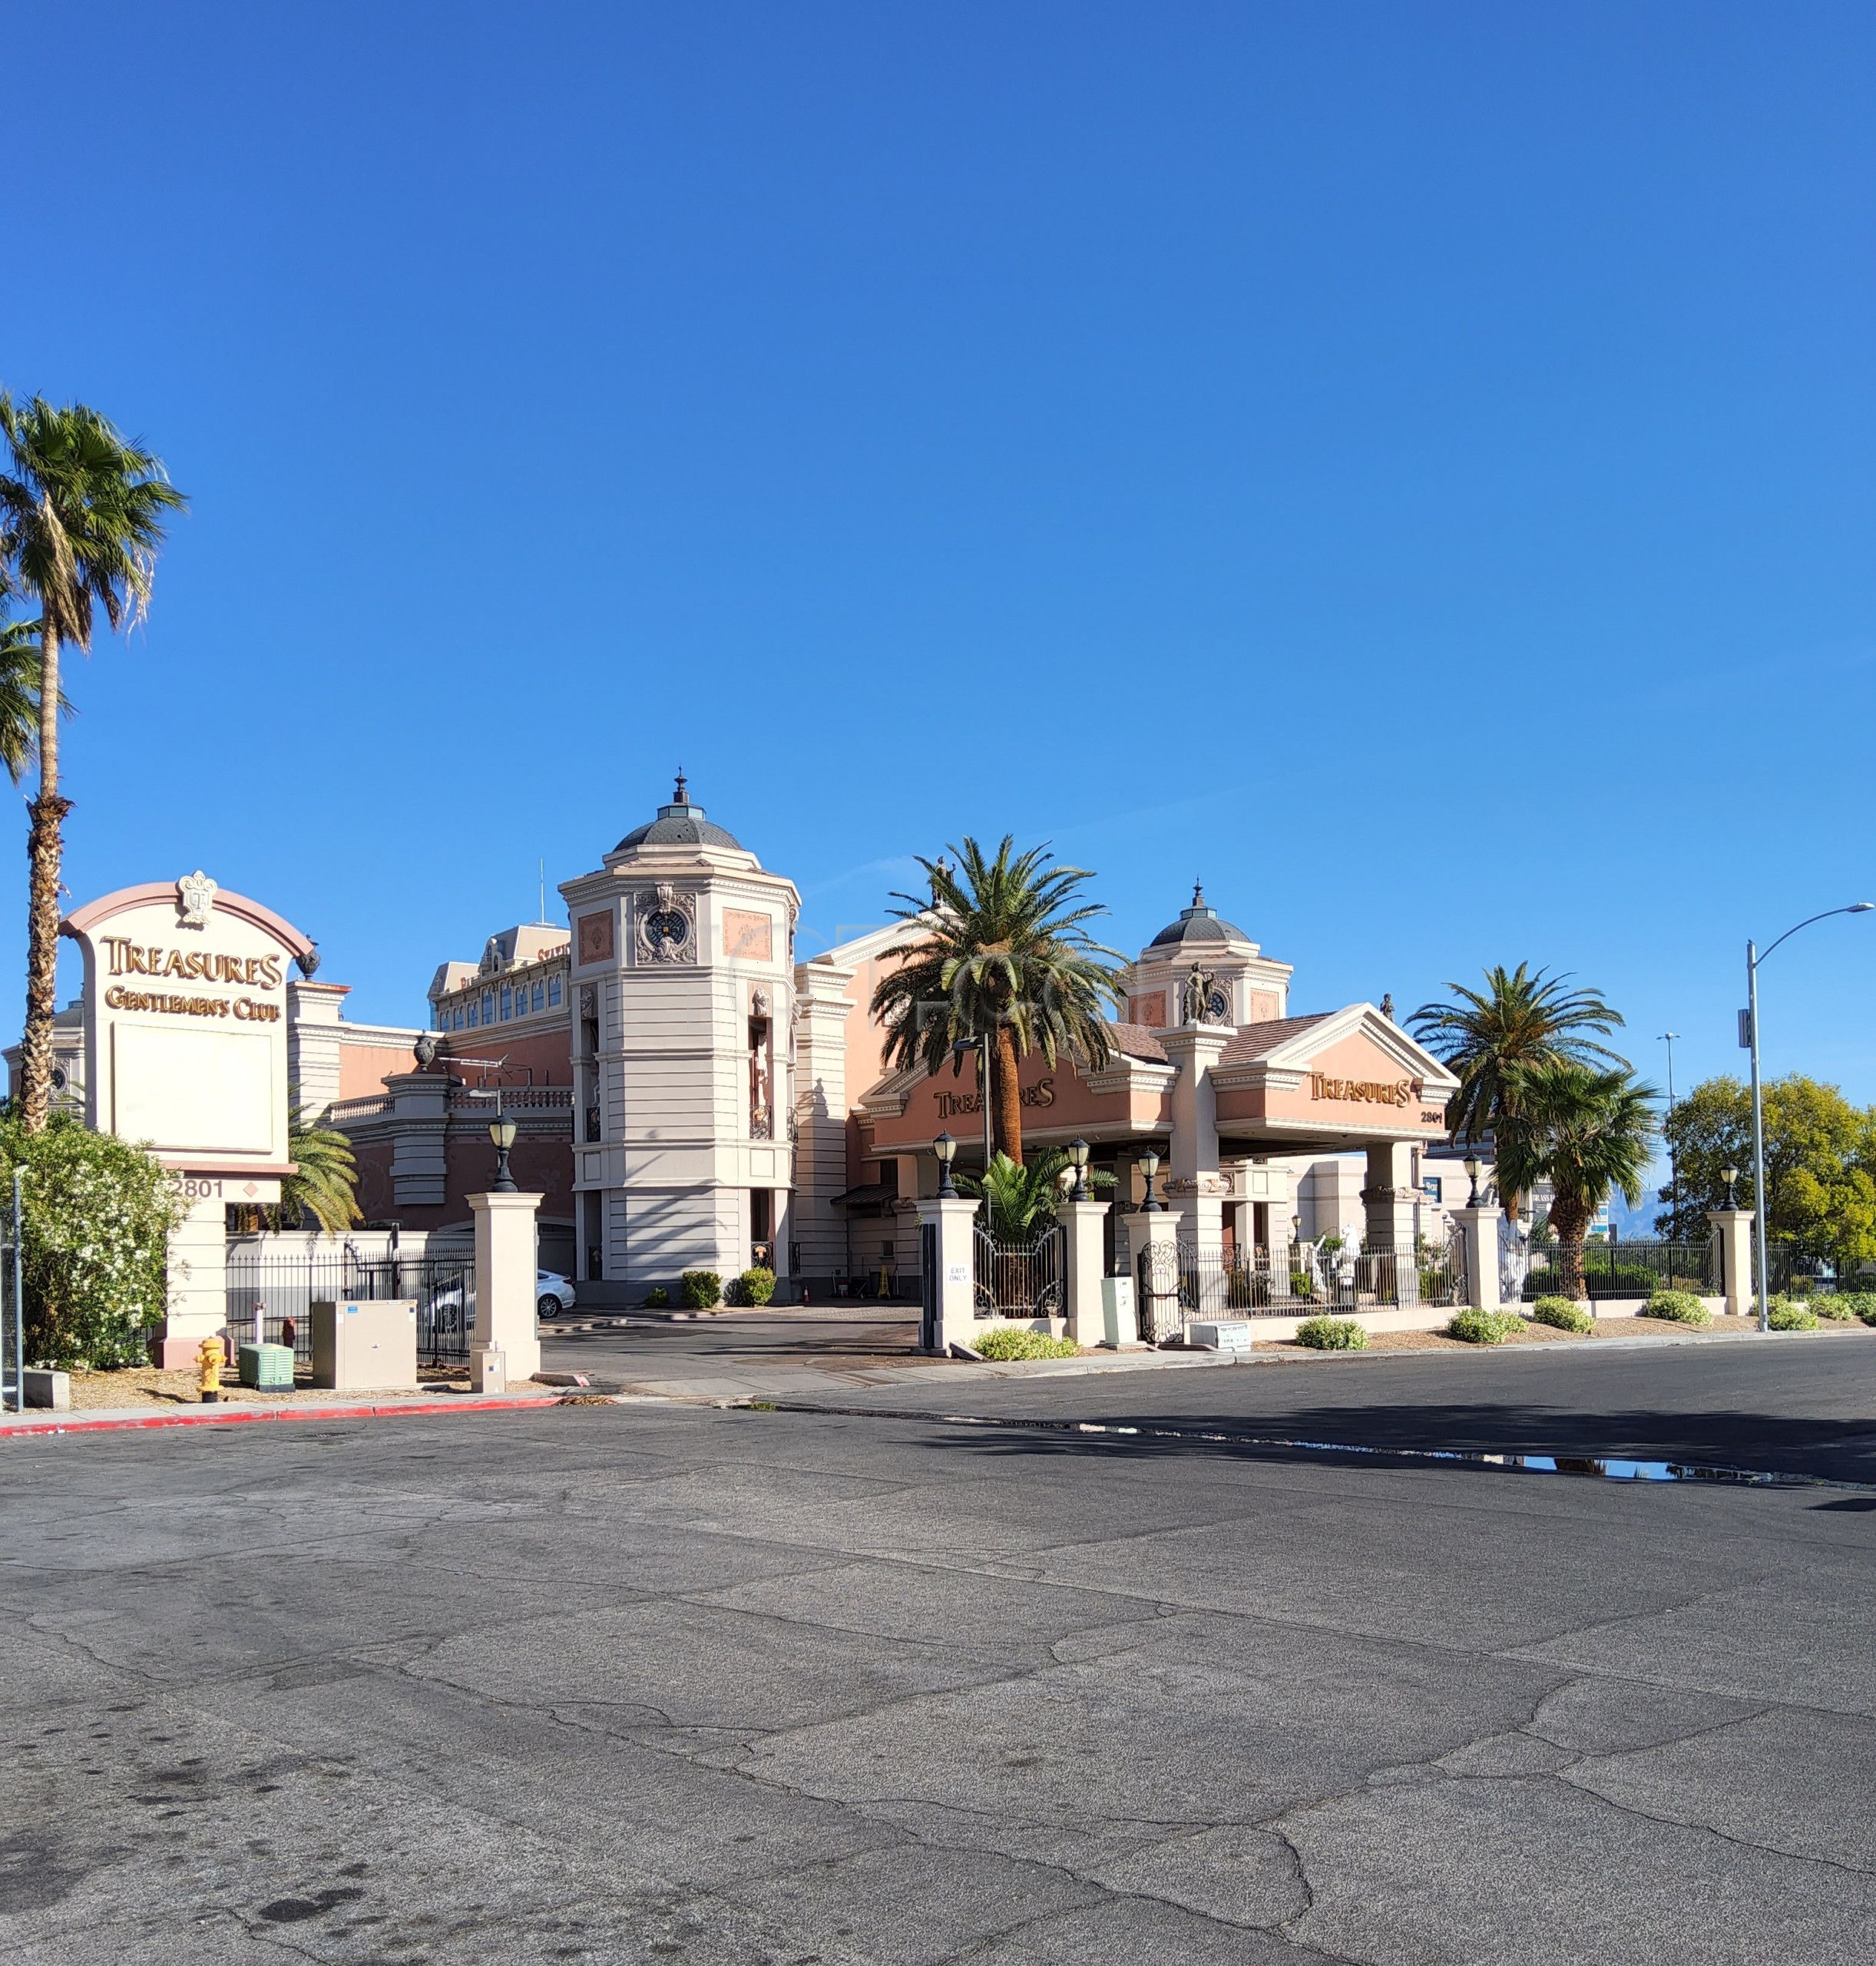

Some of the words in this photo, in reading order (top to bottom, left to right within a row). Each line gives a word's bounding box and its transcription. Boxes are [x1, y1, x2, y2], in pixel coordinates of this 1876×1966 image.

[99, 935, 283, 991] TREASURES
[104, 985, 230, 1018] GENTLEMEN'S
[233, 996, 282, 1023] CLUB
[933, 1077, 1055, 1119] TREARES
[1306, 1071, 1411, 1108] TREASURES
